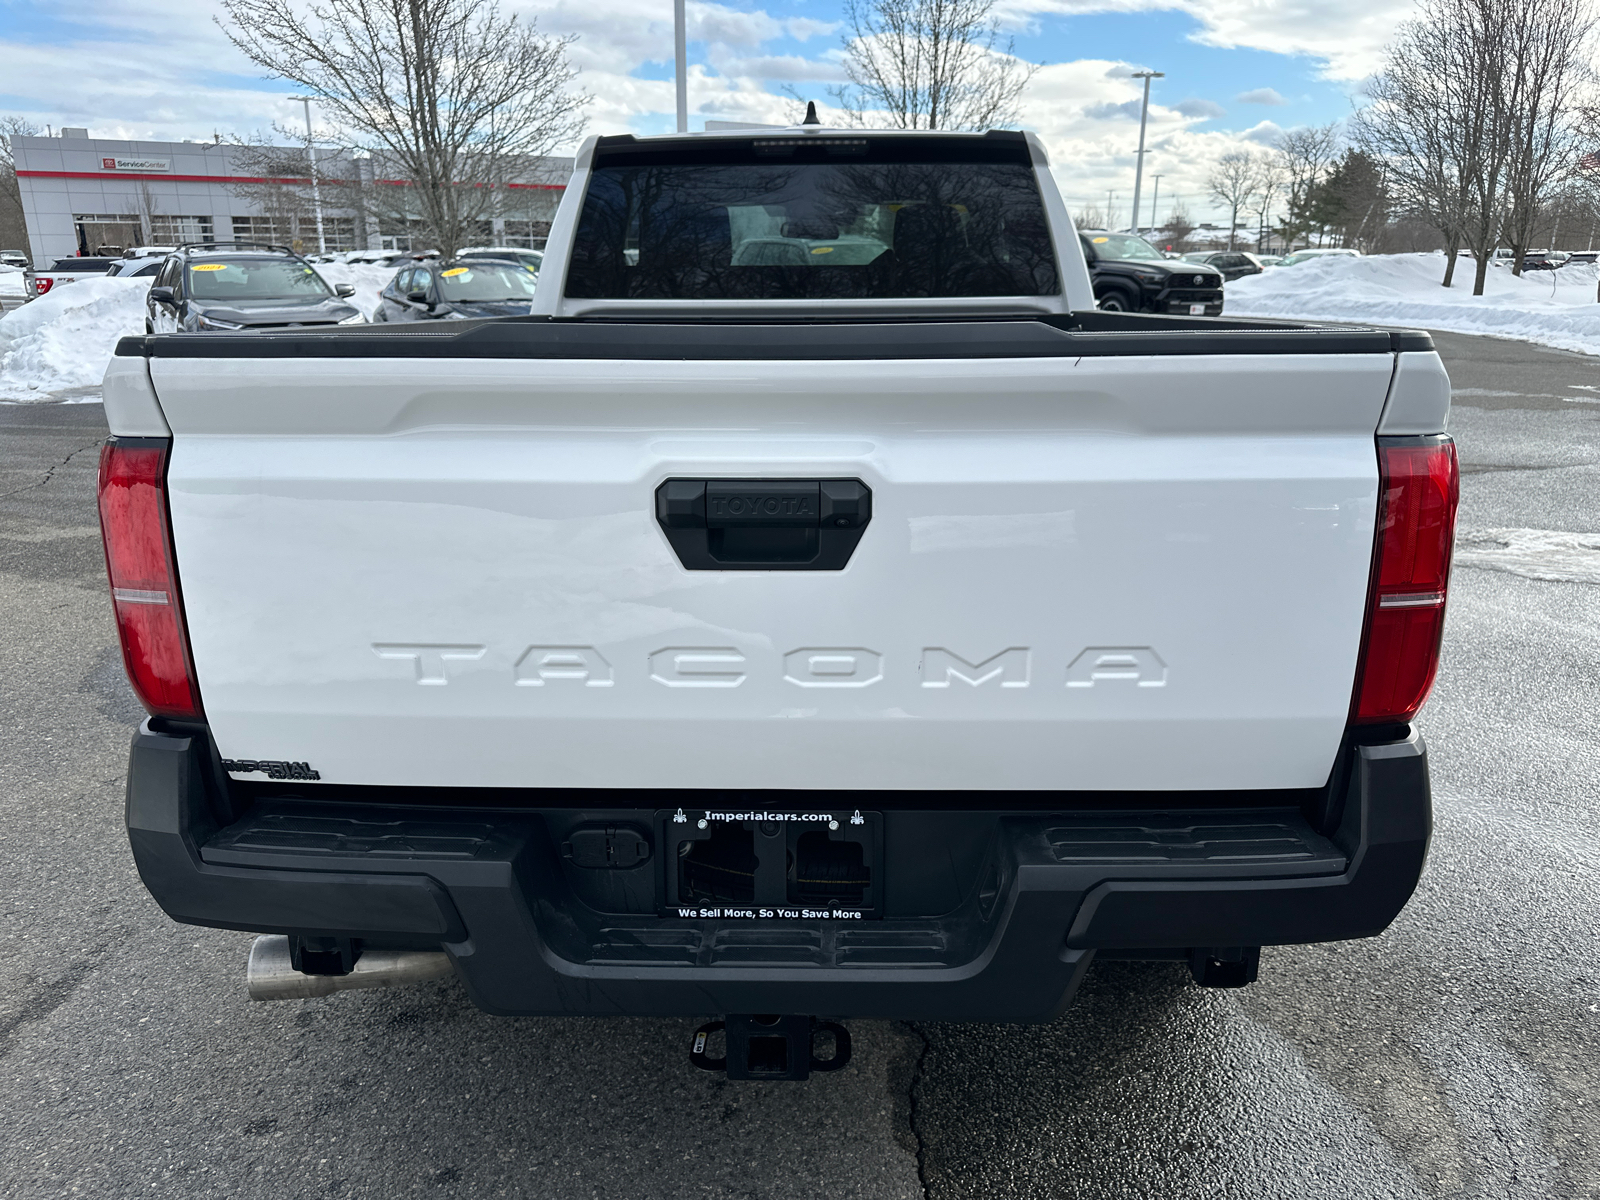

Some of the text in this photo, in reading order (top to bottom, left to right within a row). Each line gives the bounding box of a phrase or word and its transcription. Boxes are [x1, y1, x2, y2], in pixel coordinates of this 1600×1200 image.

[712, 497, 815, 515] TOYOTA
[370, 641, 1169, 689] TACOMA
[704, 810, 833, 823] Imperialcars.com
[678, 908, 862, 919] We Sell More, So You Save More
